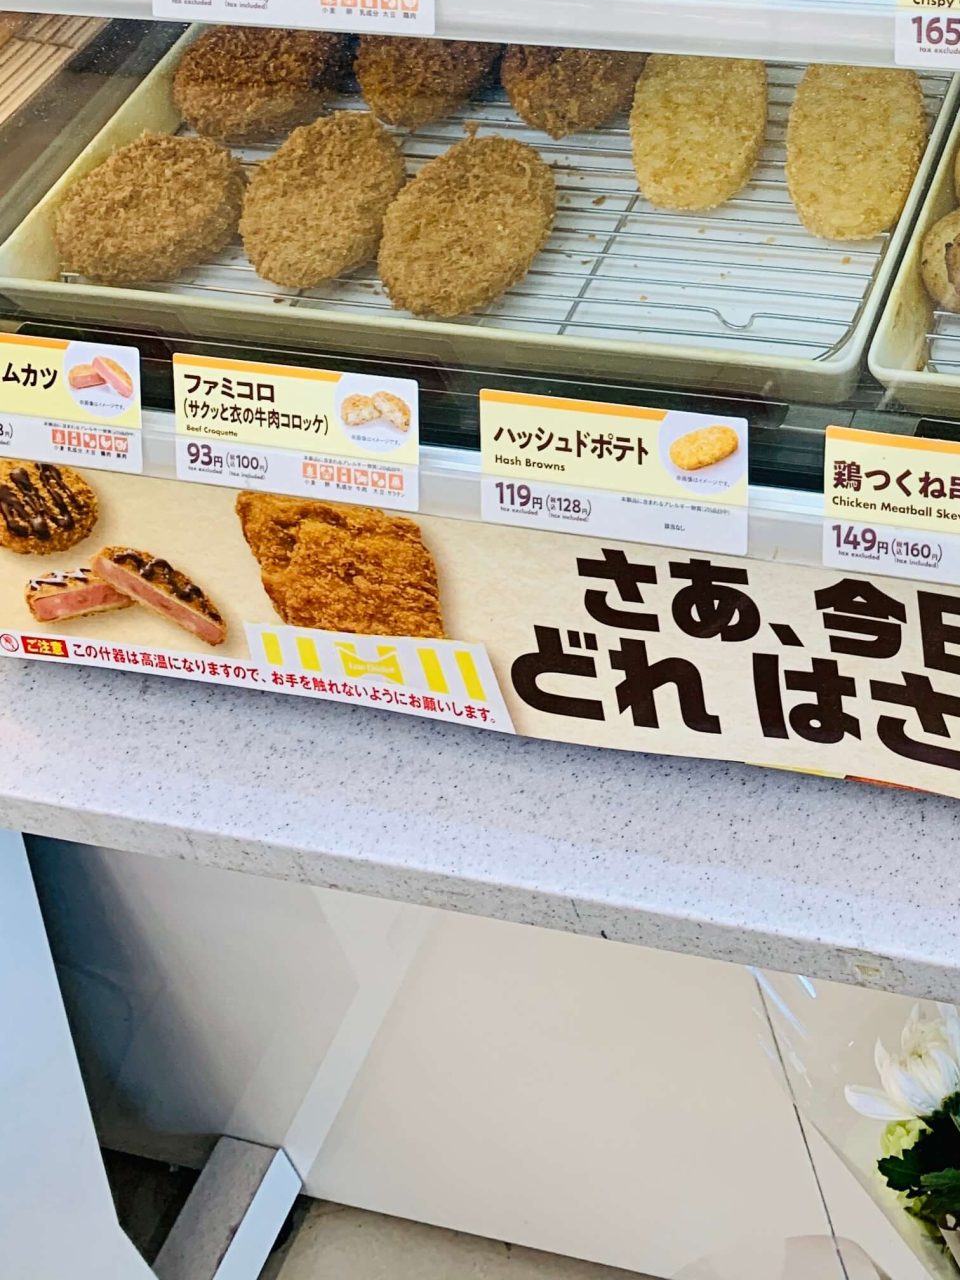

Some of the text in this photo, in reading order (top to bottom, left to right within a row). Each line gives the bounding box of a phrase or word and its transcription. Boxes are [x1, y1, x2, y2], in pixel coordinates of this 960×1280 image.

[183, 373, 276, 404] ファミコロ
[183, 397, 329, 436] (サクッと衣の牛肉コロッケ)
[187, 442, 224, 469] 93円
[493, 425, 650, 467] ハッシュドポテト
[494, 454, 566, 473] Hash Browns
[495, 481, 544, 510] 119円
[832, 495, 877, 512] Chicken
[880, 501, 933, 519] Meatball
[831, 523, 889, 556] 149円
[26, 637, 65, 657] ご注意
[72, 642, 498, 725] この什器は高温になりますので、お手を触れないようにお願いします。
[510, 623, 723, 736] どれ
